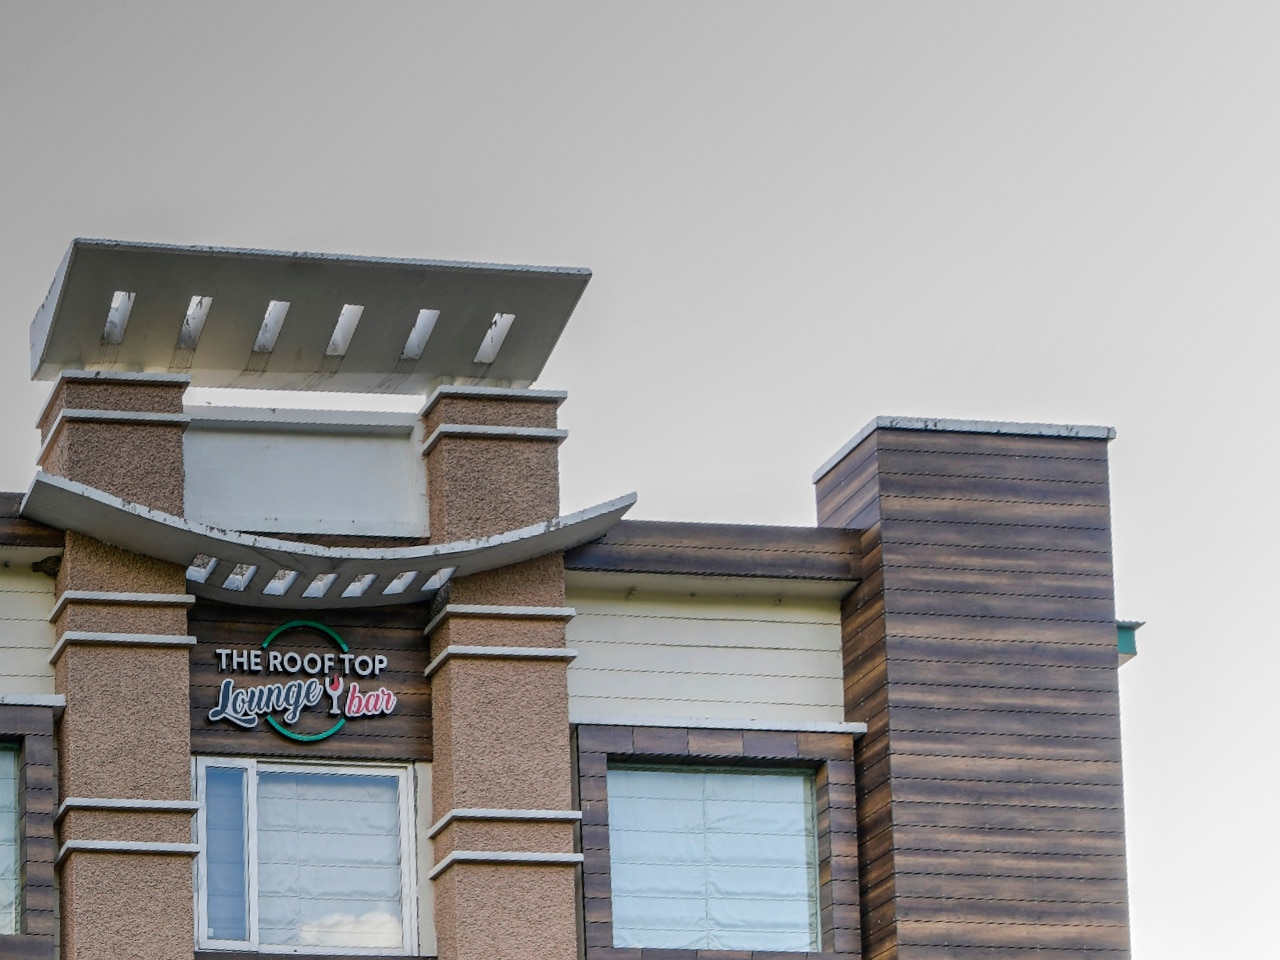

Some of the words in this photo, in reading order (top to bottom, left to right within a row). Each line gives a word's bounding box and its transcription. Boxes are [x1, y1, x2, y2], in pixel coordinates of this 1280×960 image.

[215, 648, 263, 671] THE
[208, 678, 323, 728] Lounge
[345, 682, 397, 718] bar
